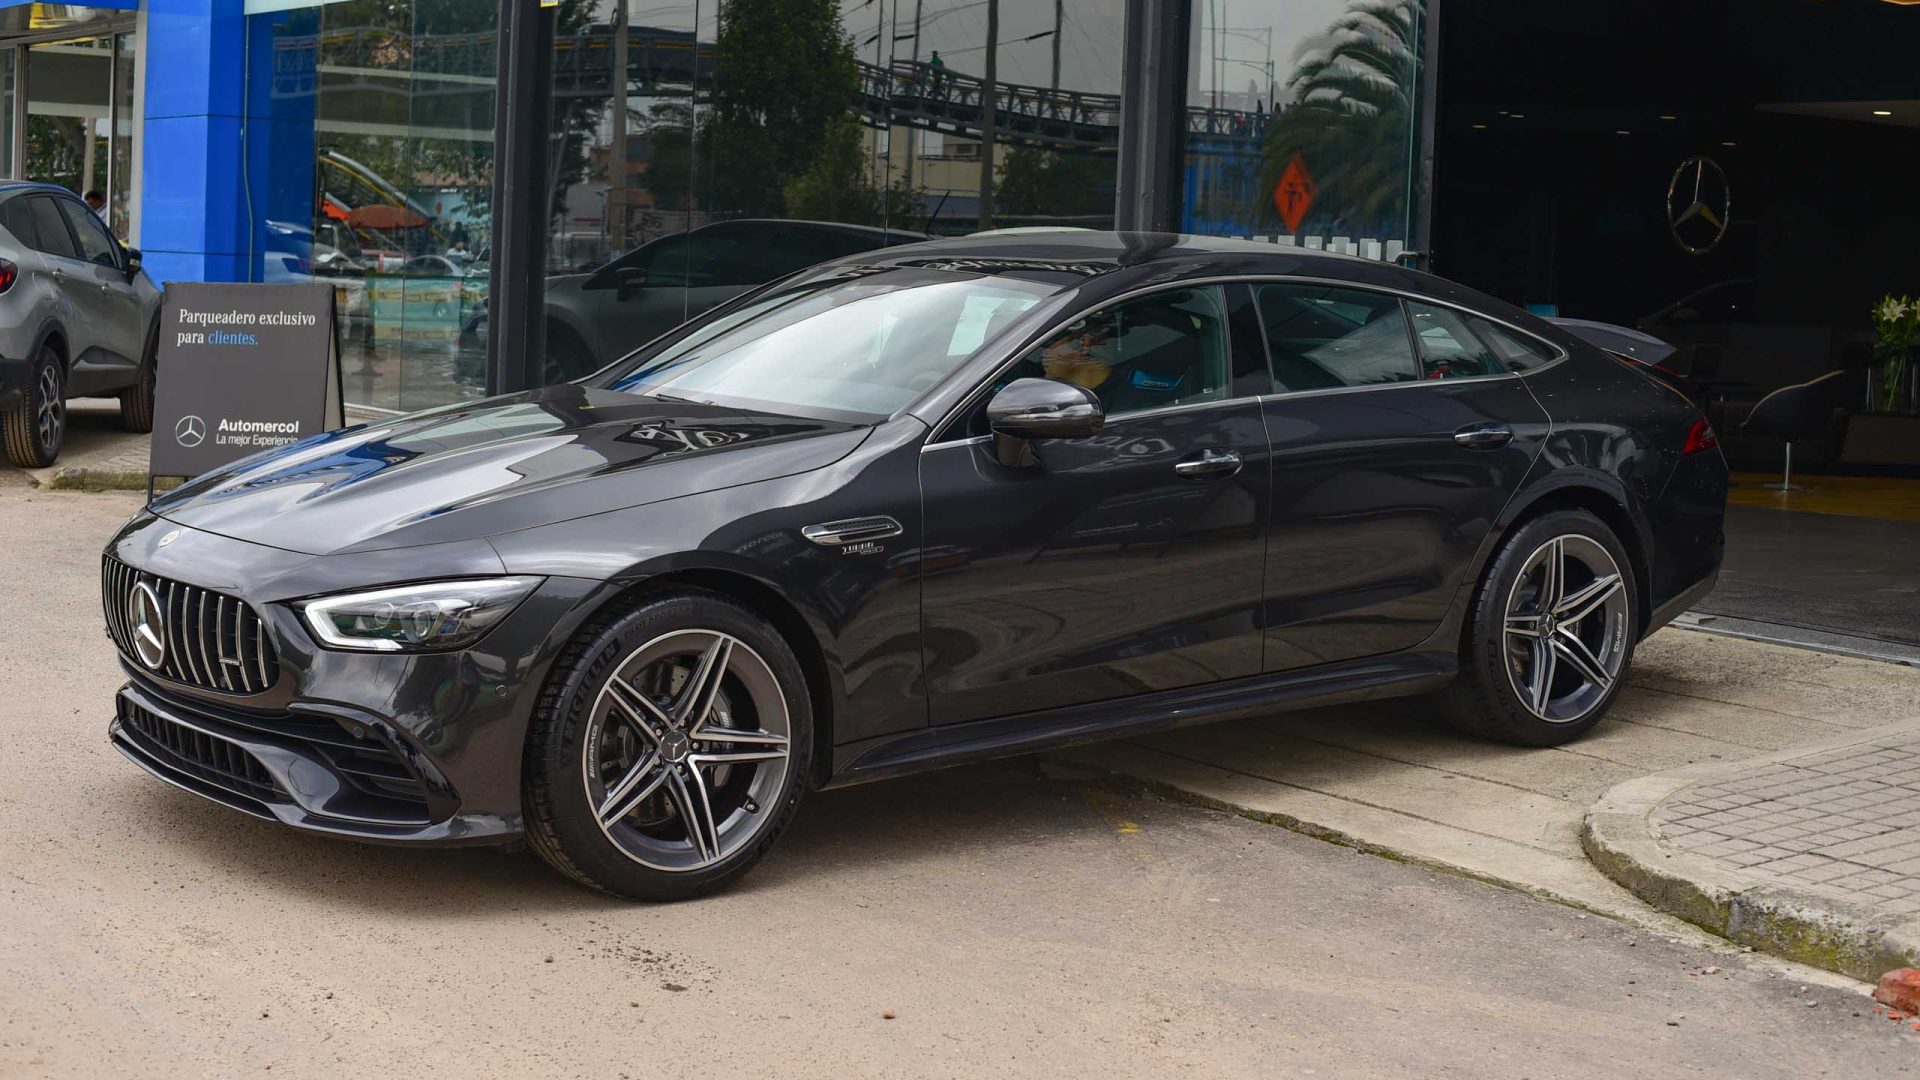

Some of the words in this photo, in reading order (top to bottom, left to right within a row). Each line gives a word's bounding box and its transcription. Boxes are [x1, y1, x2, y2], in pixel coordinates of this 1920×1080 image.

[179, 308, 256, 327] Parqueadero
[259, 310, 316, 326] exclusivo
[177, 331, 204, 347] para
[208, 330, 258, 345] clientes.
[218, 418, 299, 433] Automercol
[216, 433, 227, 444] La
[228, 434, 251, 447] mejor
